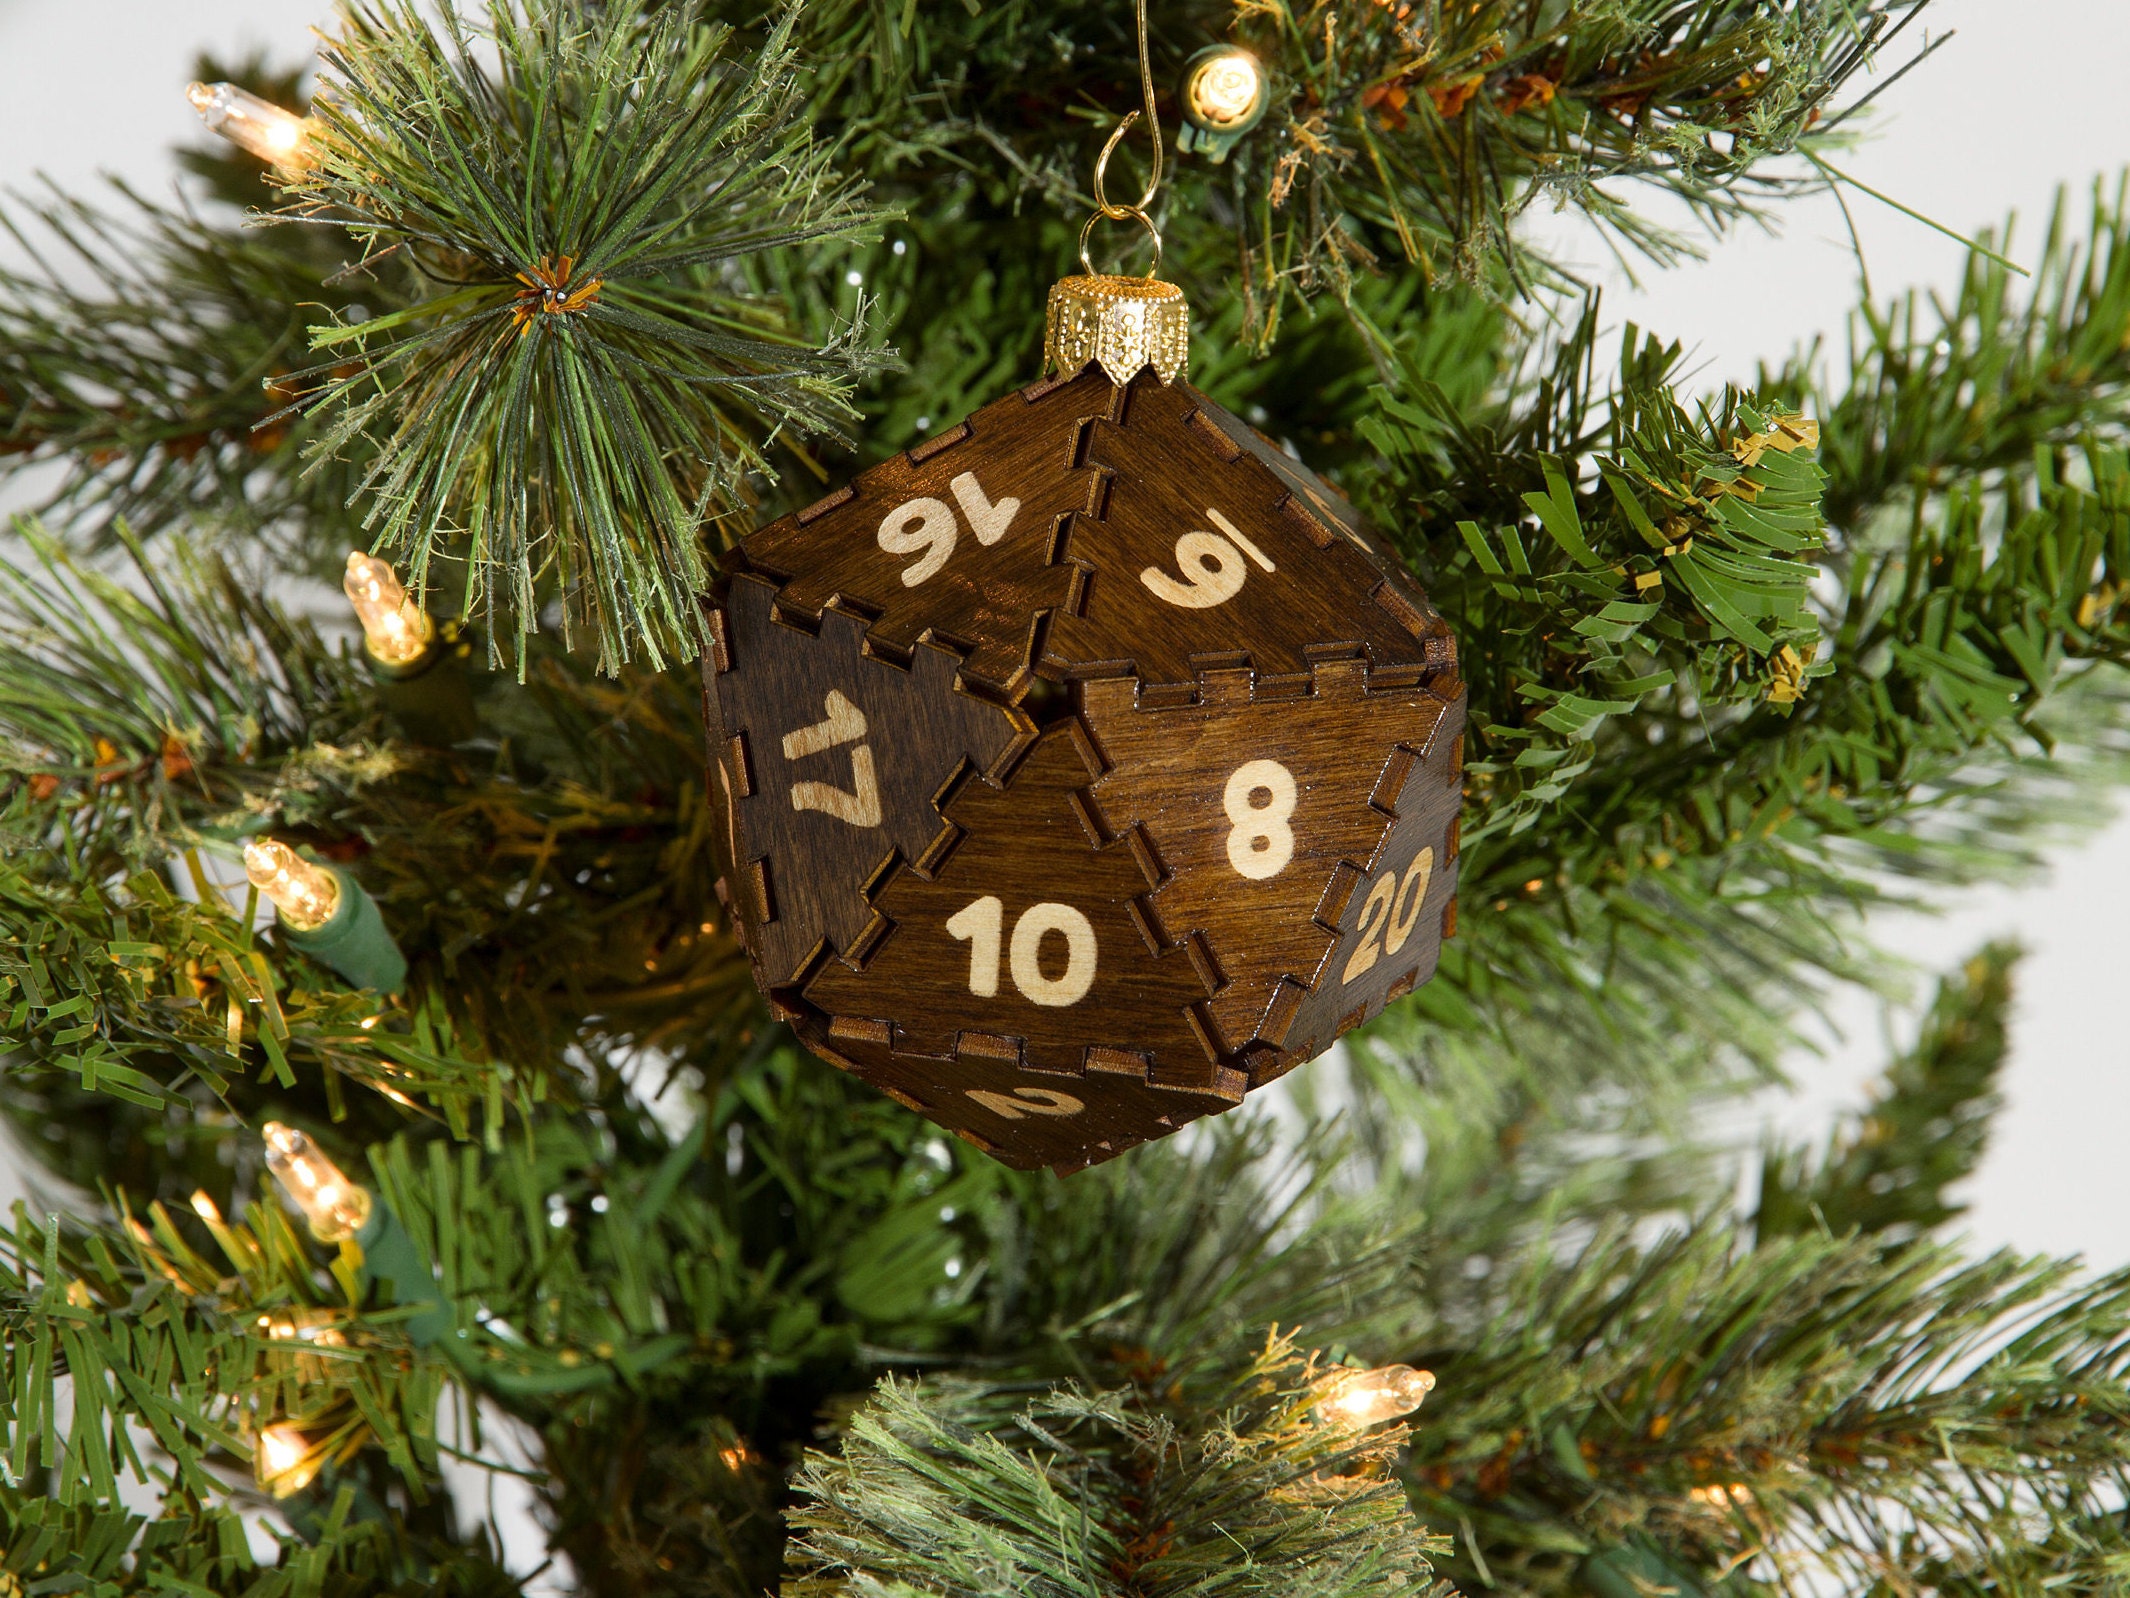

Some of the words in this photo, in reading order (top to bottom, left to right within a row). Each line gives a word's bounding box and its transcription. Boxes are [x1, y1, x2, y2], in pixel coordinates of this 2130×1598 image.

[876, 470, 1024, 588] 16
[1140, 507, 1276, 609] 6
[782, 688, 882, 828] 17
[1221, 759, 1300, 881] 8
[945, 894, 1099, 1008] 10
[1341, 846, 1435, 986] 20
